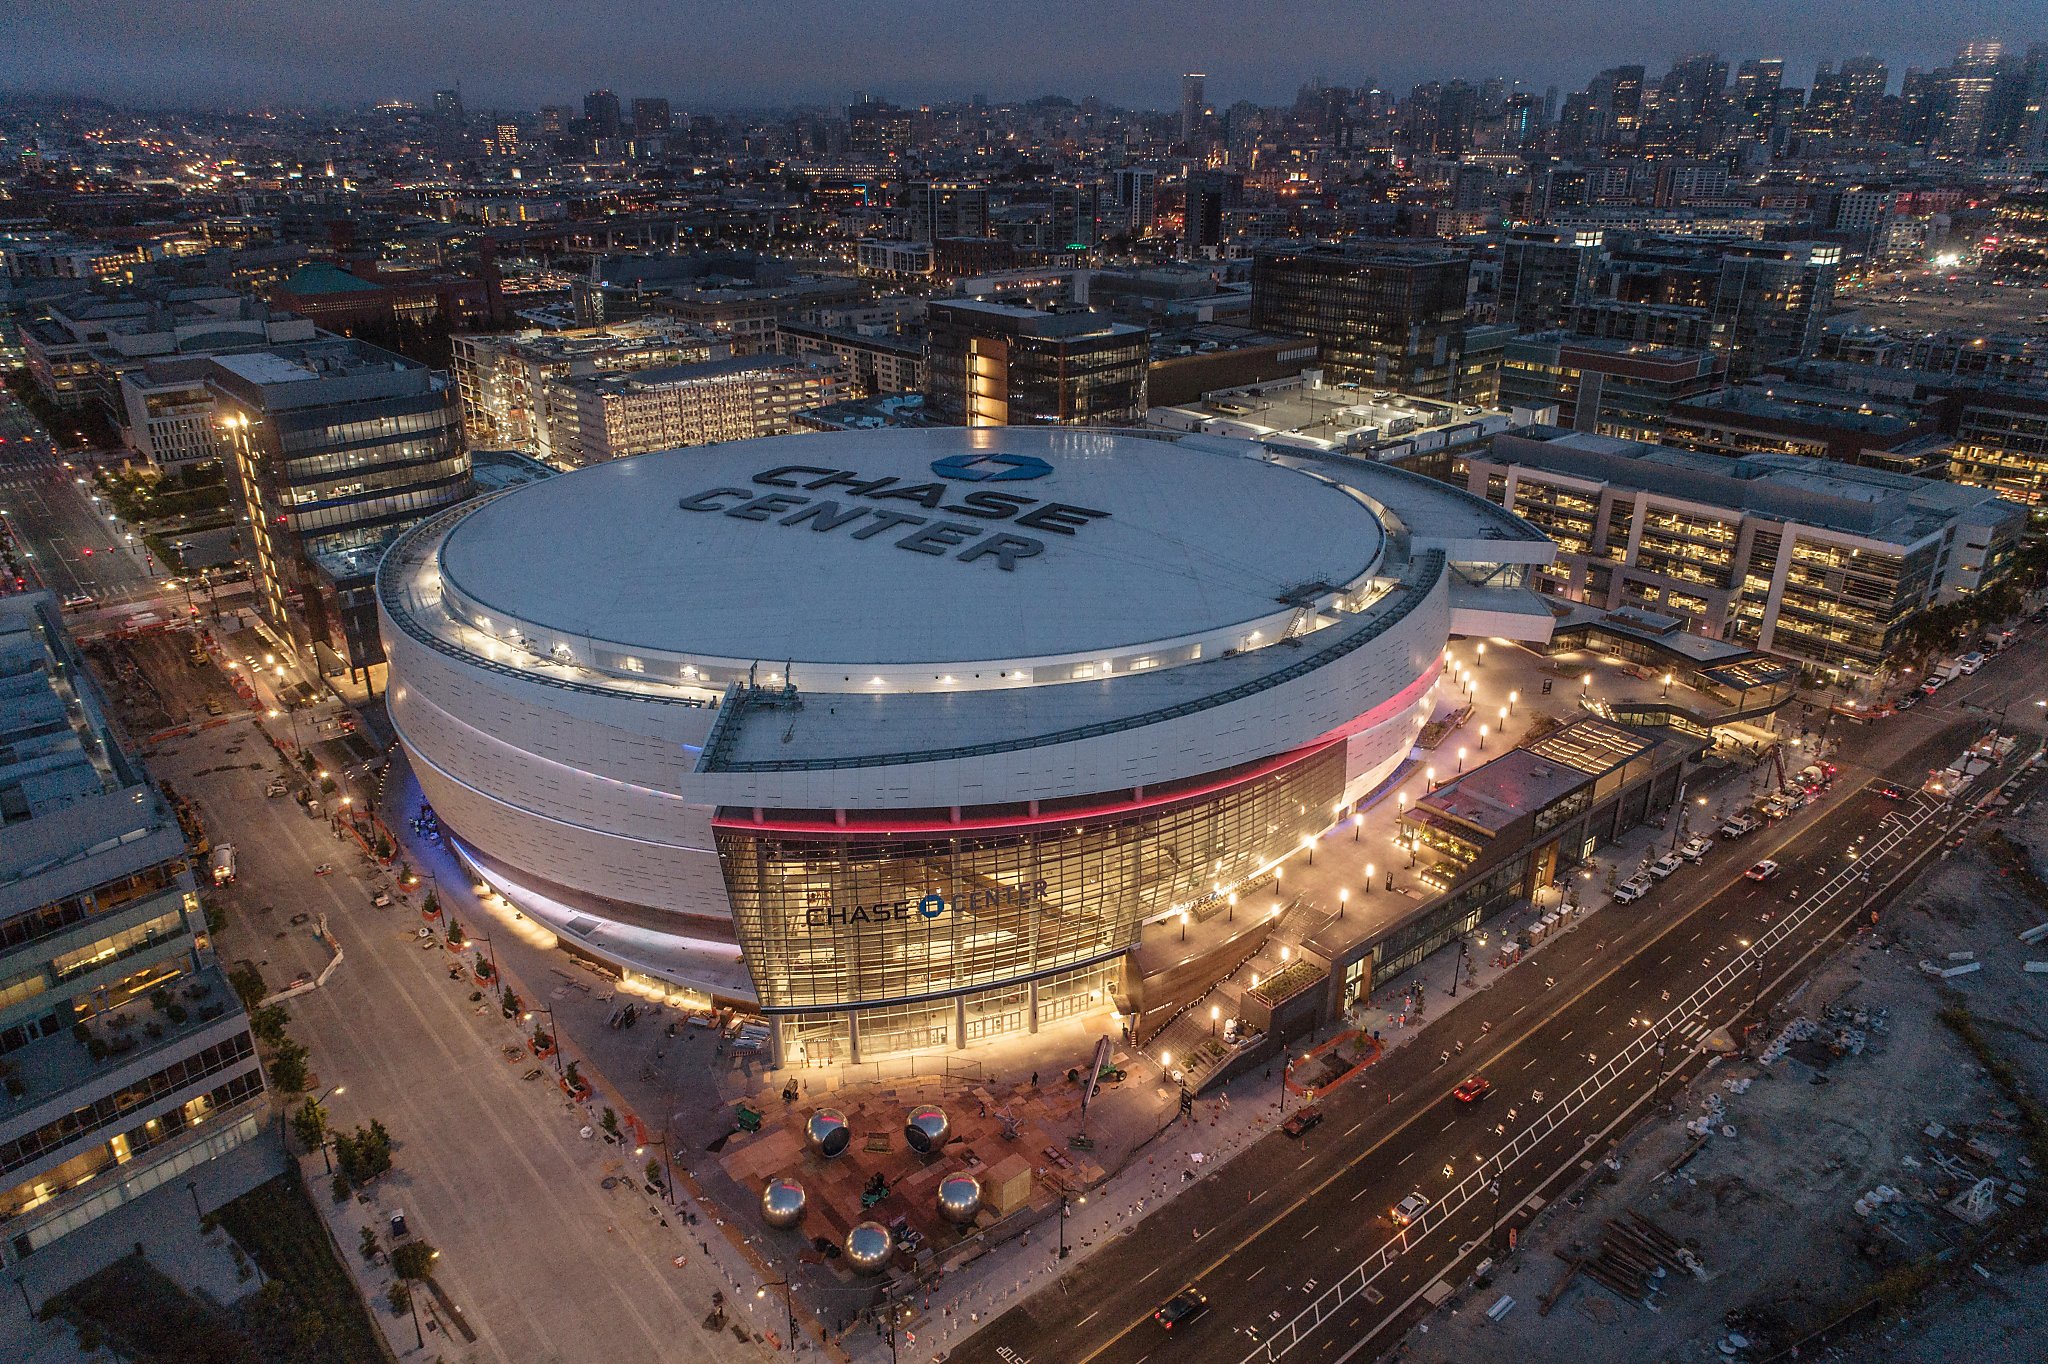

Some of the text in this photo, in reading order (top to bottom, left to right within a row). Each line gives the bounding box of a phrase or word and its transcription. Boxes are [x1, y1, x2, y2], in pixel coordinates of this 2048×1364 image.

[679, 487, 1045, 572] CENTER
[752, 465, 1113, 535] CHASE
[806, 879, 1049, 927] CHASE CENTER
